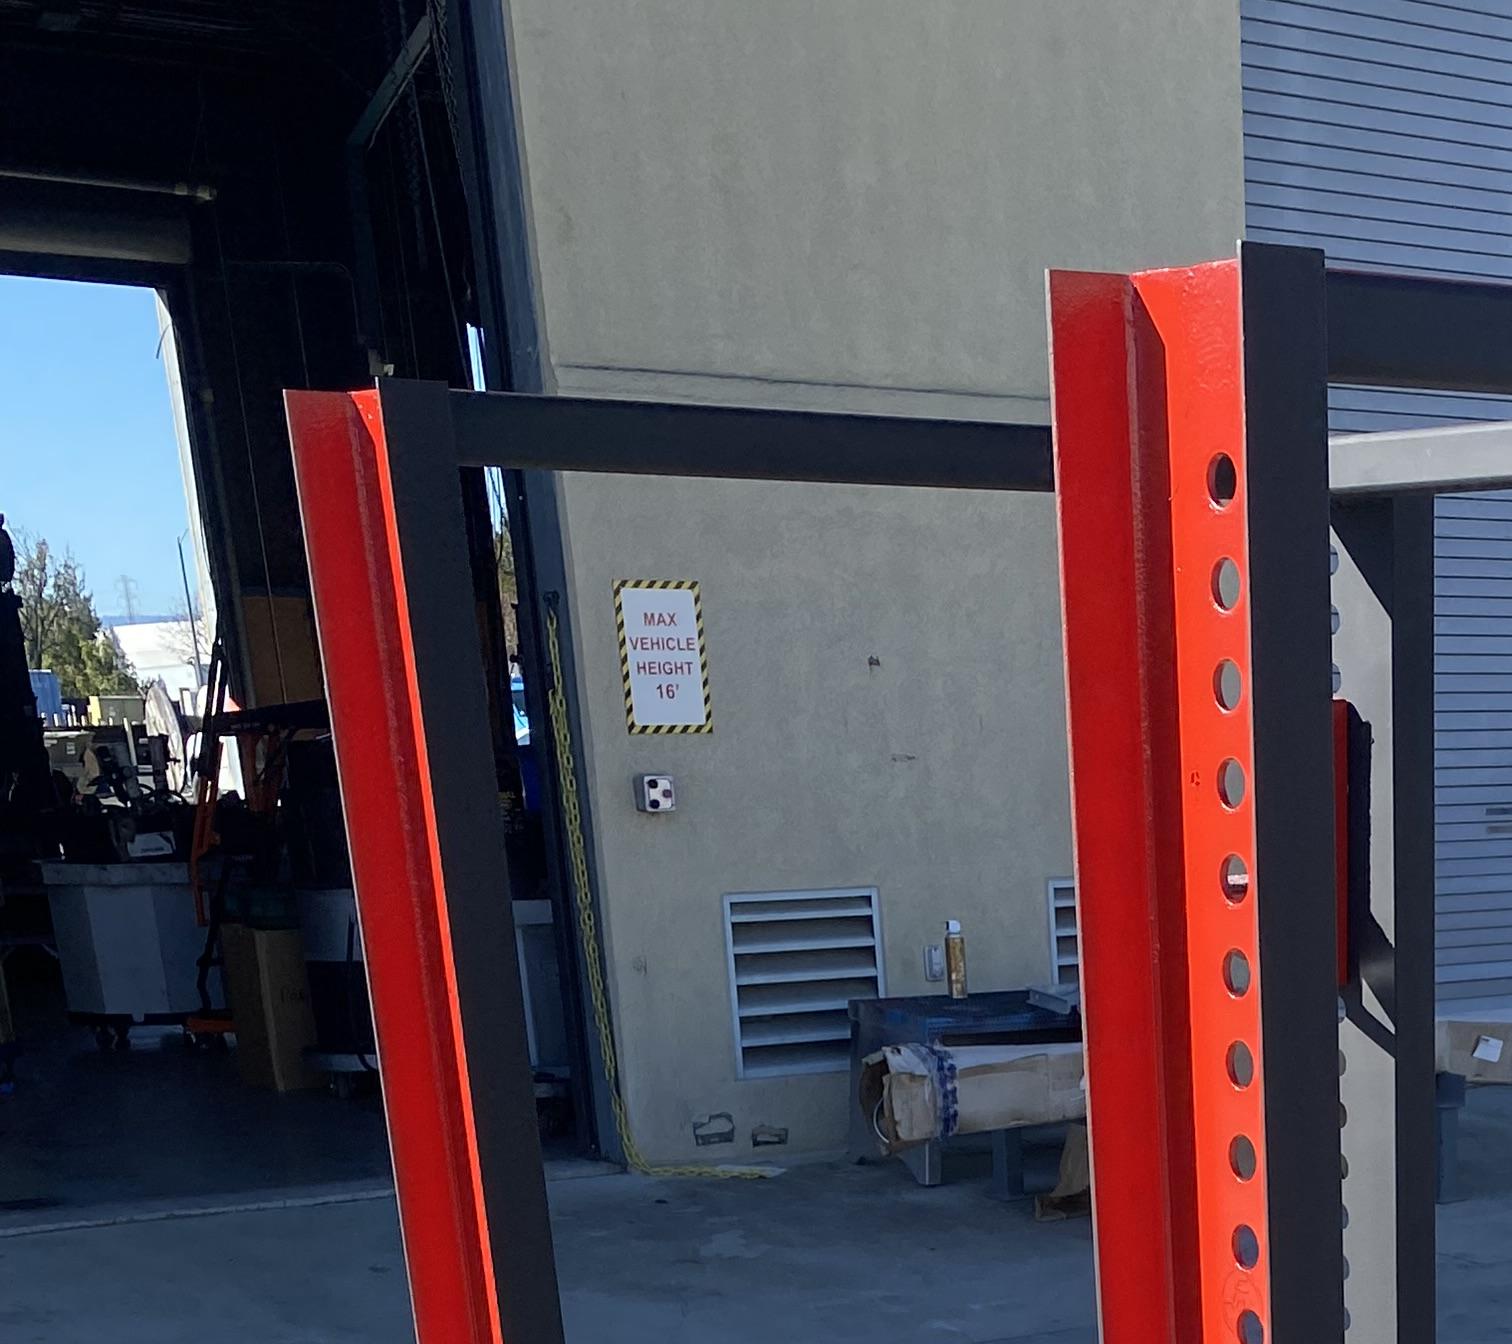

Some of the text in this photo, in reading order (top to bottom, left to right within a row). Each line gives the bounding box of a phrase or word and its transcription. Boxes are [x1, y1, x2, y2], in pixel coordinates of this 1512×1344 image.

[643, 612, 678, 627] MAX
[629, 636, 696, 651] VEHICLE
[636, 661, 694, 676] HEIGHT
[656, 683, 680, 700] 16'
